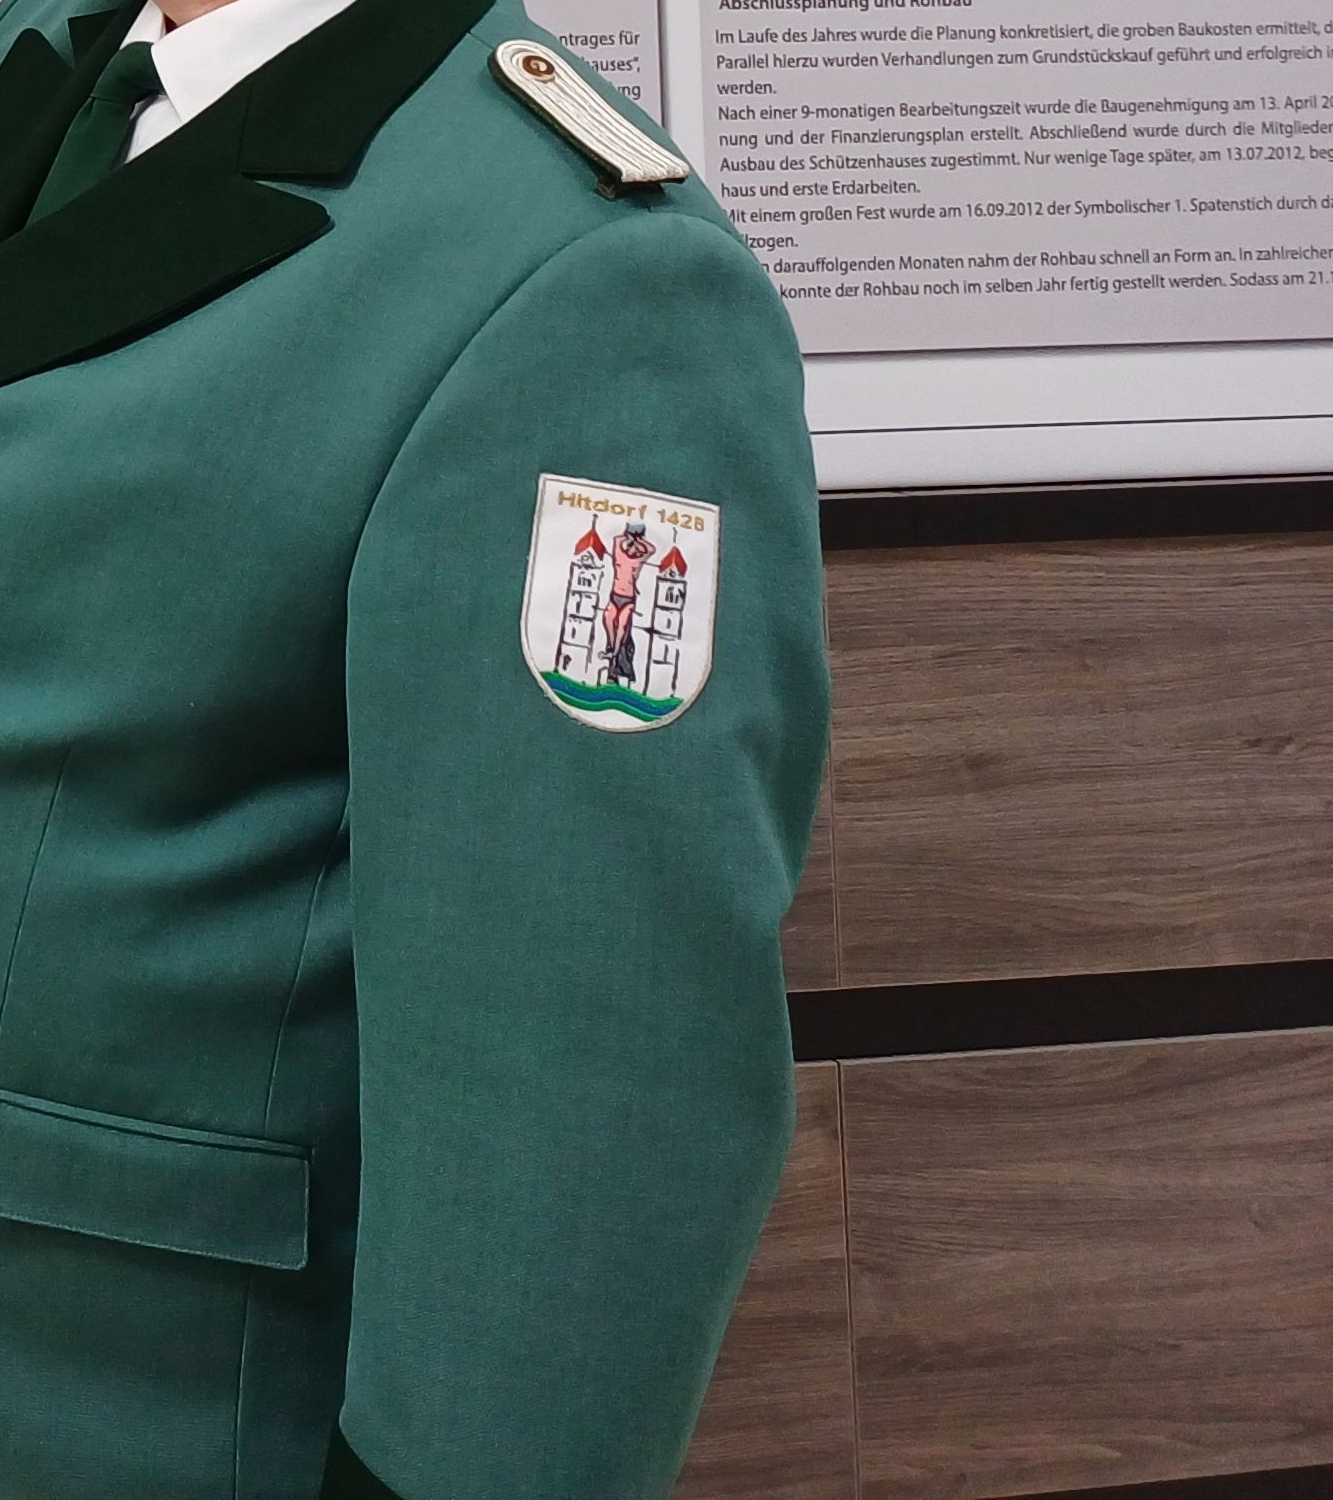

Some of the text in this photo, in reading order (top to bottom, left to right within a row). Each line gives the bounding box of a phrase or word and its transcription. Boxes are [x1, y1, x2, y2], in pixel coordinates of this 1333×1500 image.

[715, 20, 1321, 44] Im Laufe des Jahres wurde die Planung konkretisiert, die groben Baukosten ermittelt,
[716, 79, 778, 94] werden.
[720, 179, 921, 197] haus und erste Erdarbeiten.
[557, 490, 705, 533] Hitdorf 1428
